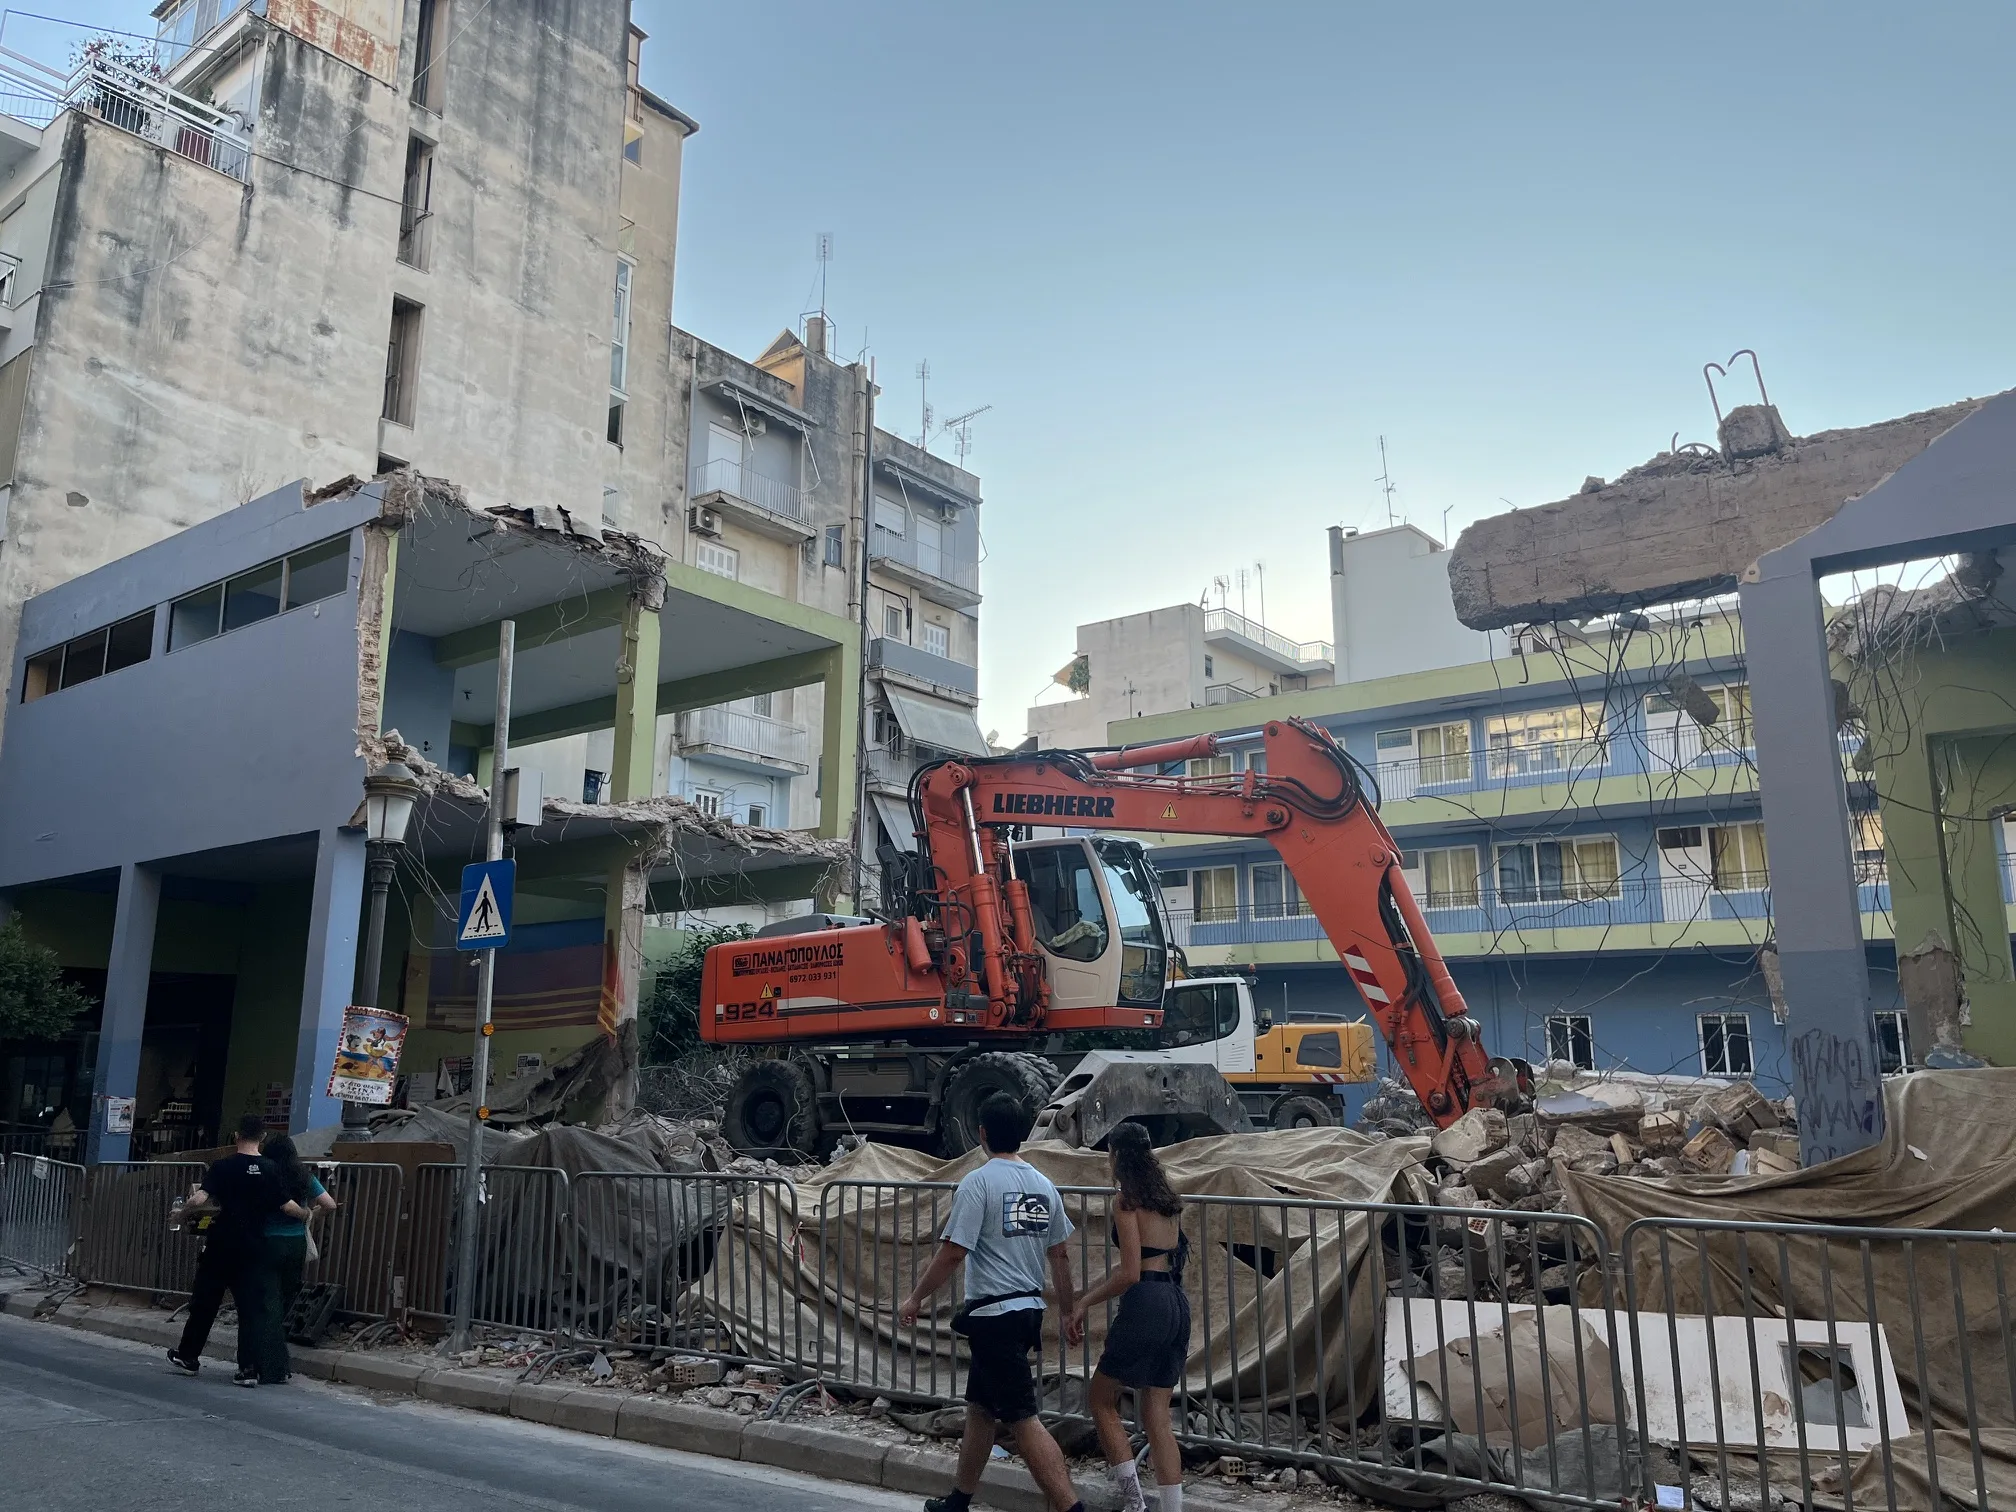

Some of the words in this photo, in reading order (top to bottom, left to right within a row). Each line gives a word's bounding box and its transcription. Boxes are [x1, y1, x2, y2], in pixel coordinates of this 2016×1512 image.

[993, 793, 1115, 818] LIEBHERR
[752, 943, 844, 968] ΠΑΝΑΓΟΠΟΥΛΟΣ
[789, 975, 806, 984] 6972
[808, 973, 821, 981] 033
[824, 971, 837, 979] 931
[725, 1000, 775, 1021] 924
